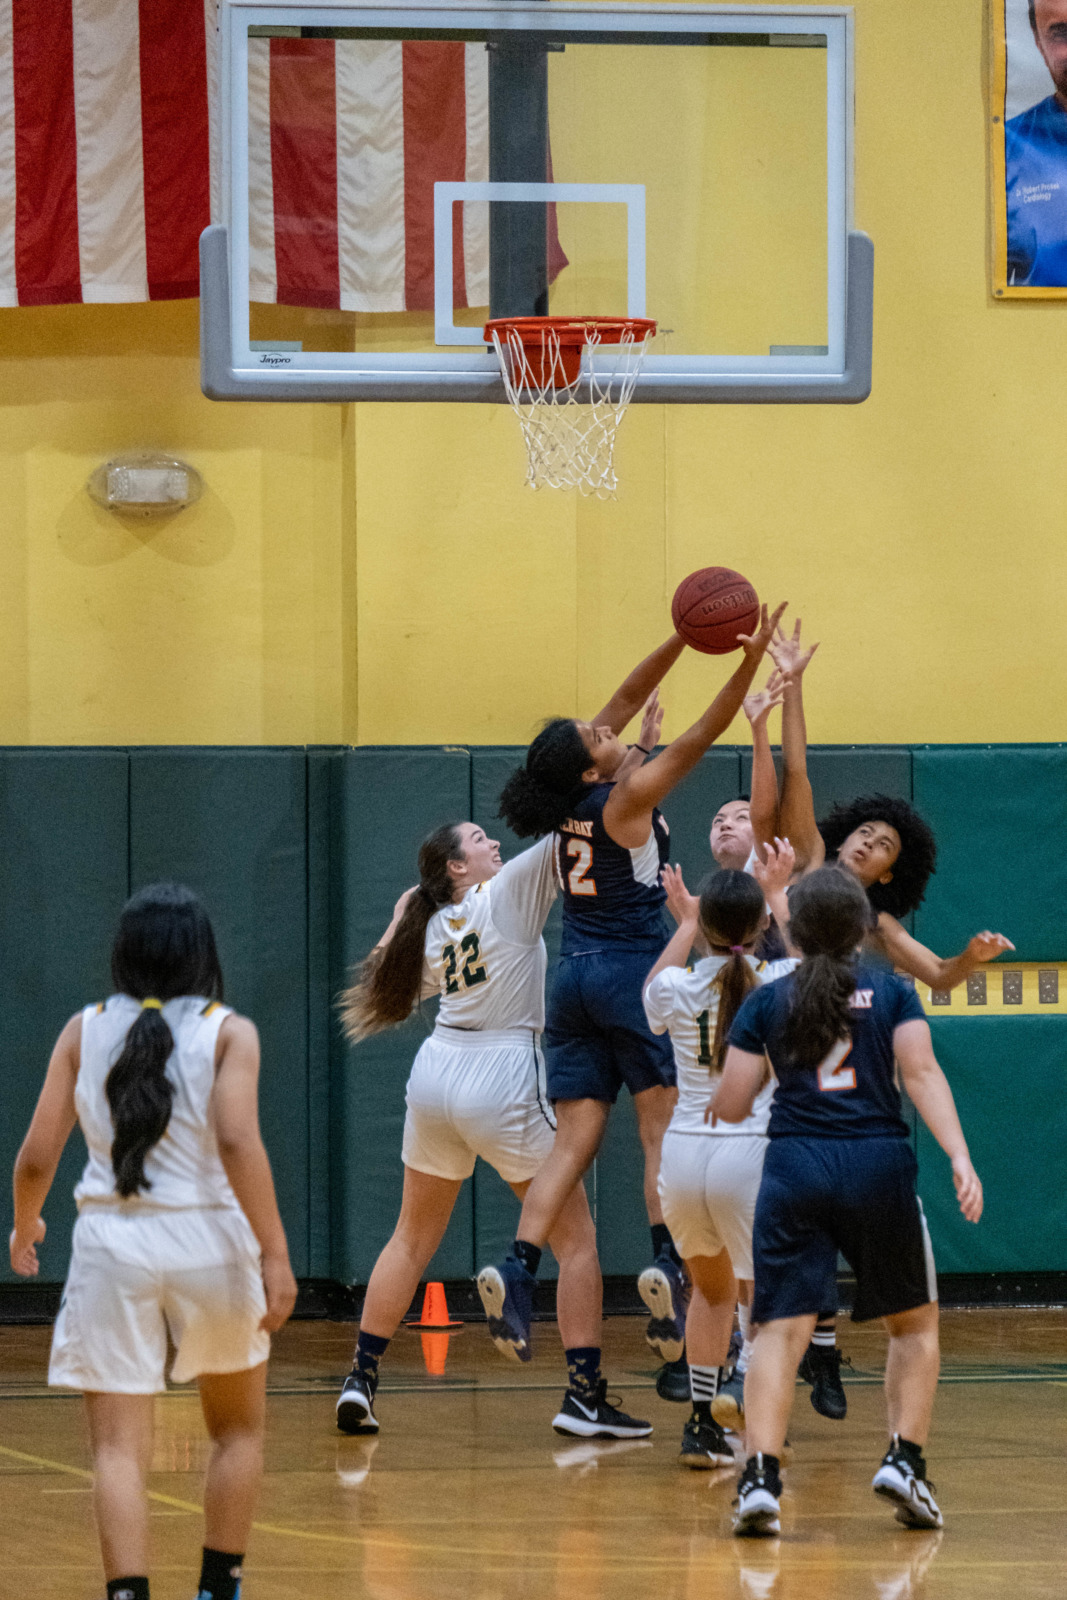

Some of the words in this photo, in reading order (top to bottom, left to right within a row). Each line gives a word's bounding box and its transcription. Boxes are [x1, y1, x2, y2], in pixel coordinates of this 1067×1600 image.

[260, 354, 291, 364] Jaypro
[701, 589, 756, 615] Wilson
[567, 838, 597, 896] 2
[441, 928, 490, 995] 22
[817, 1036, 857, 1091] 2
